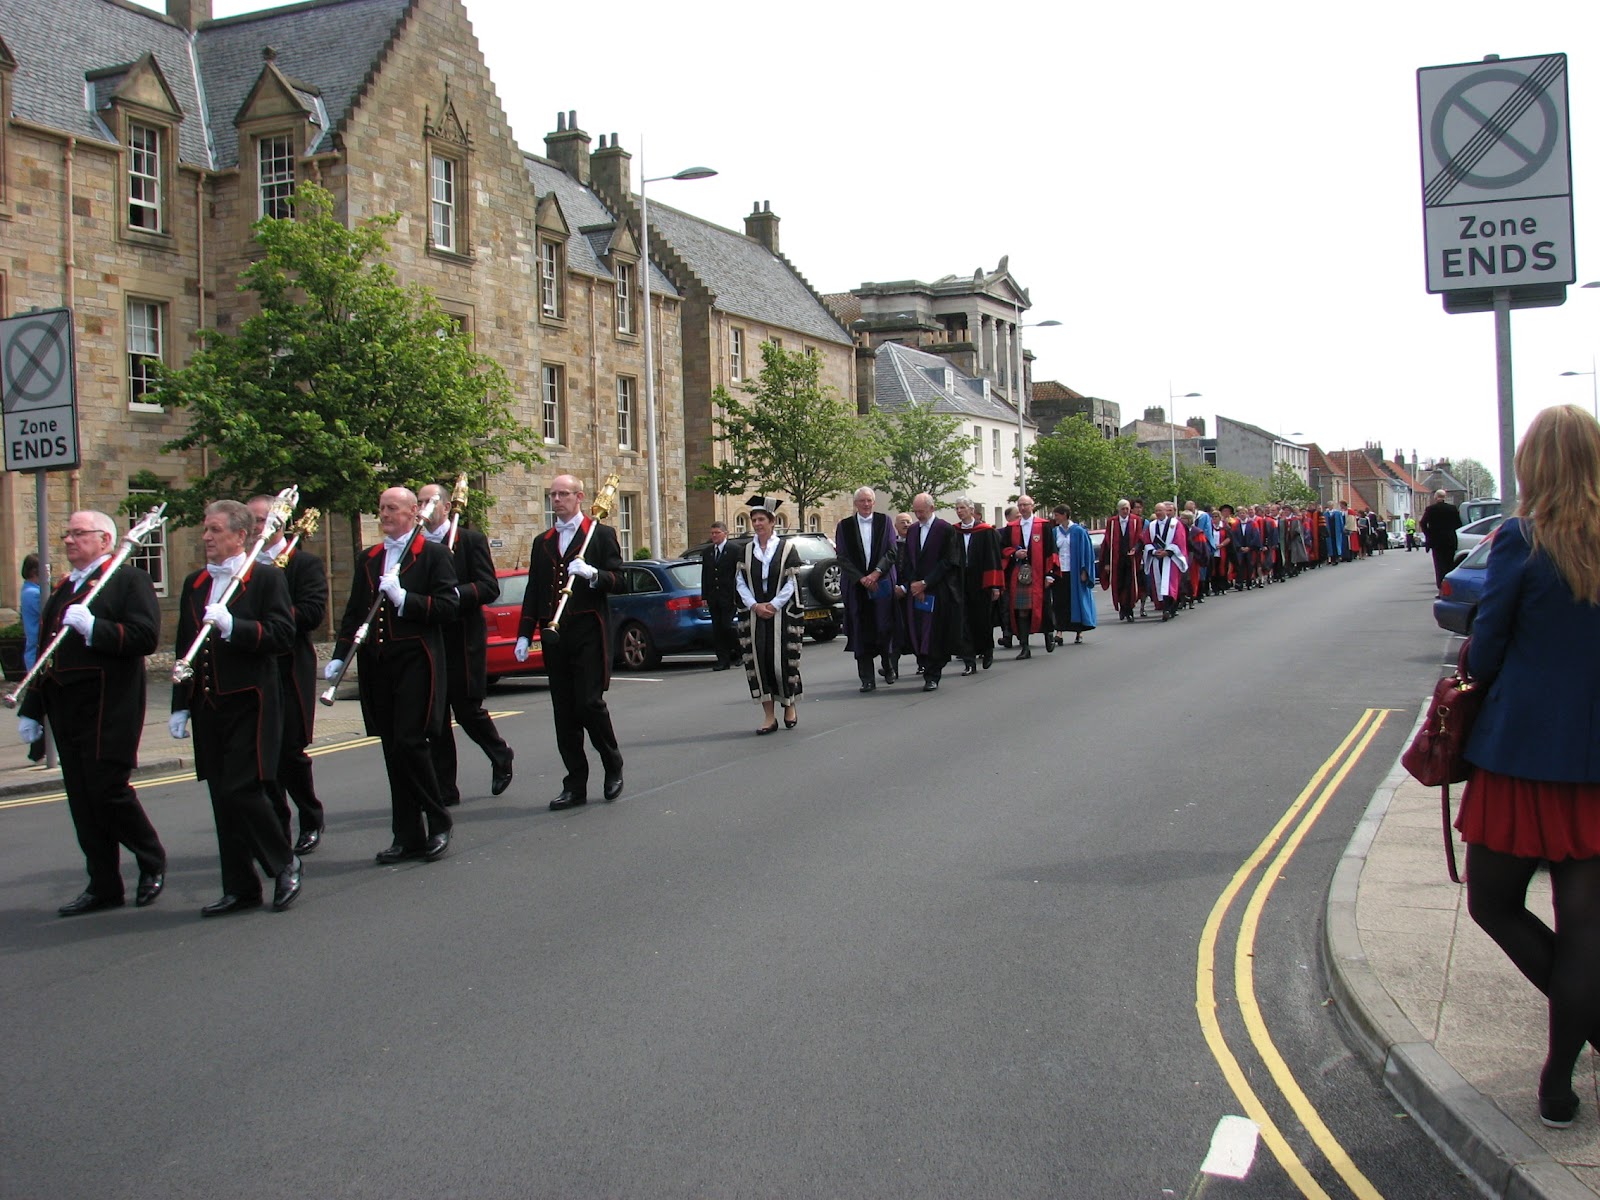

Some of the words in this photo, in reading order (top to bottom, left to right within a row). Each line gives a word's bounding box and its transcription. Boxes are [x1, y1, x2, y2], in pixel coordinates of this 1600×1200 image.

[1459, 216, 1537, 240] Zone
[1442, 241, 1557, 278] ENDS
[20, 419, 57, 435] Zone
[12, 436, 67, 461] ENDS
